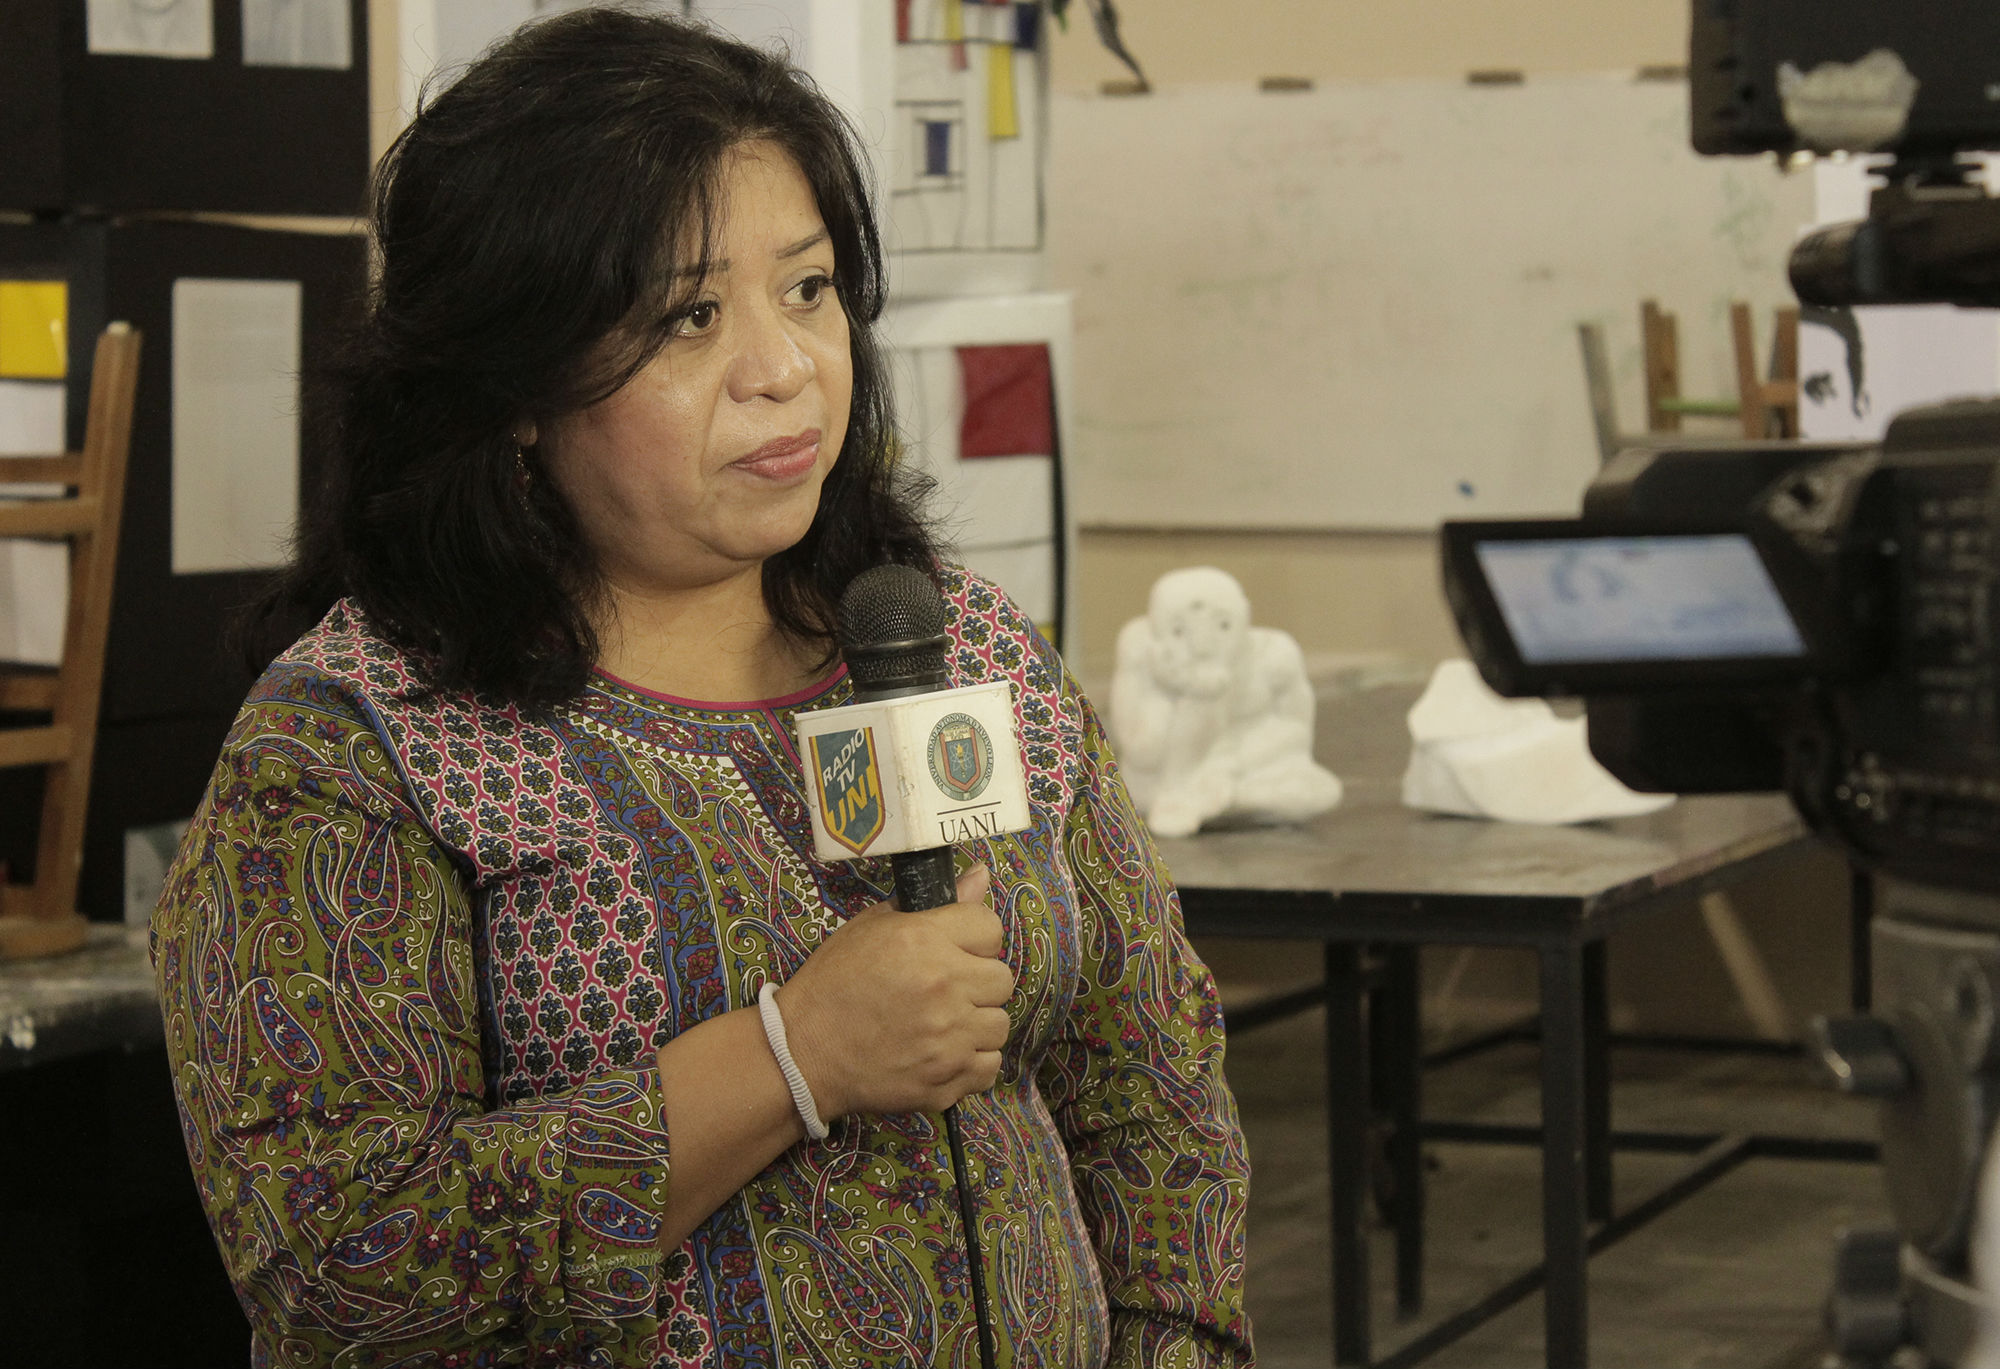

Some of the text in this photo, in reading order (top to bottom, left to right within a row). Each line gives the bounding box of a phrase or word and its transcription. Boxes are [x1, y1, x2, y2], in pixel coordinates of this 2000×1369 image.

[823, 728, 865, 787] RADIO
[837, 759, 856, 792] TV
[938, 811, 1006, 843] UANL
